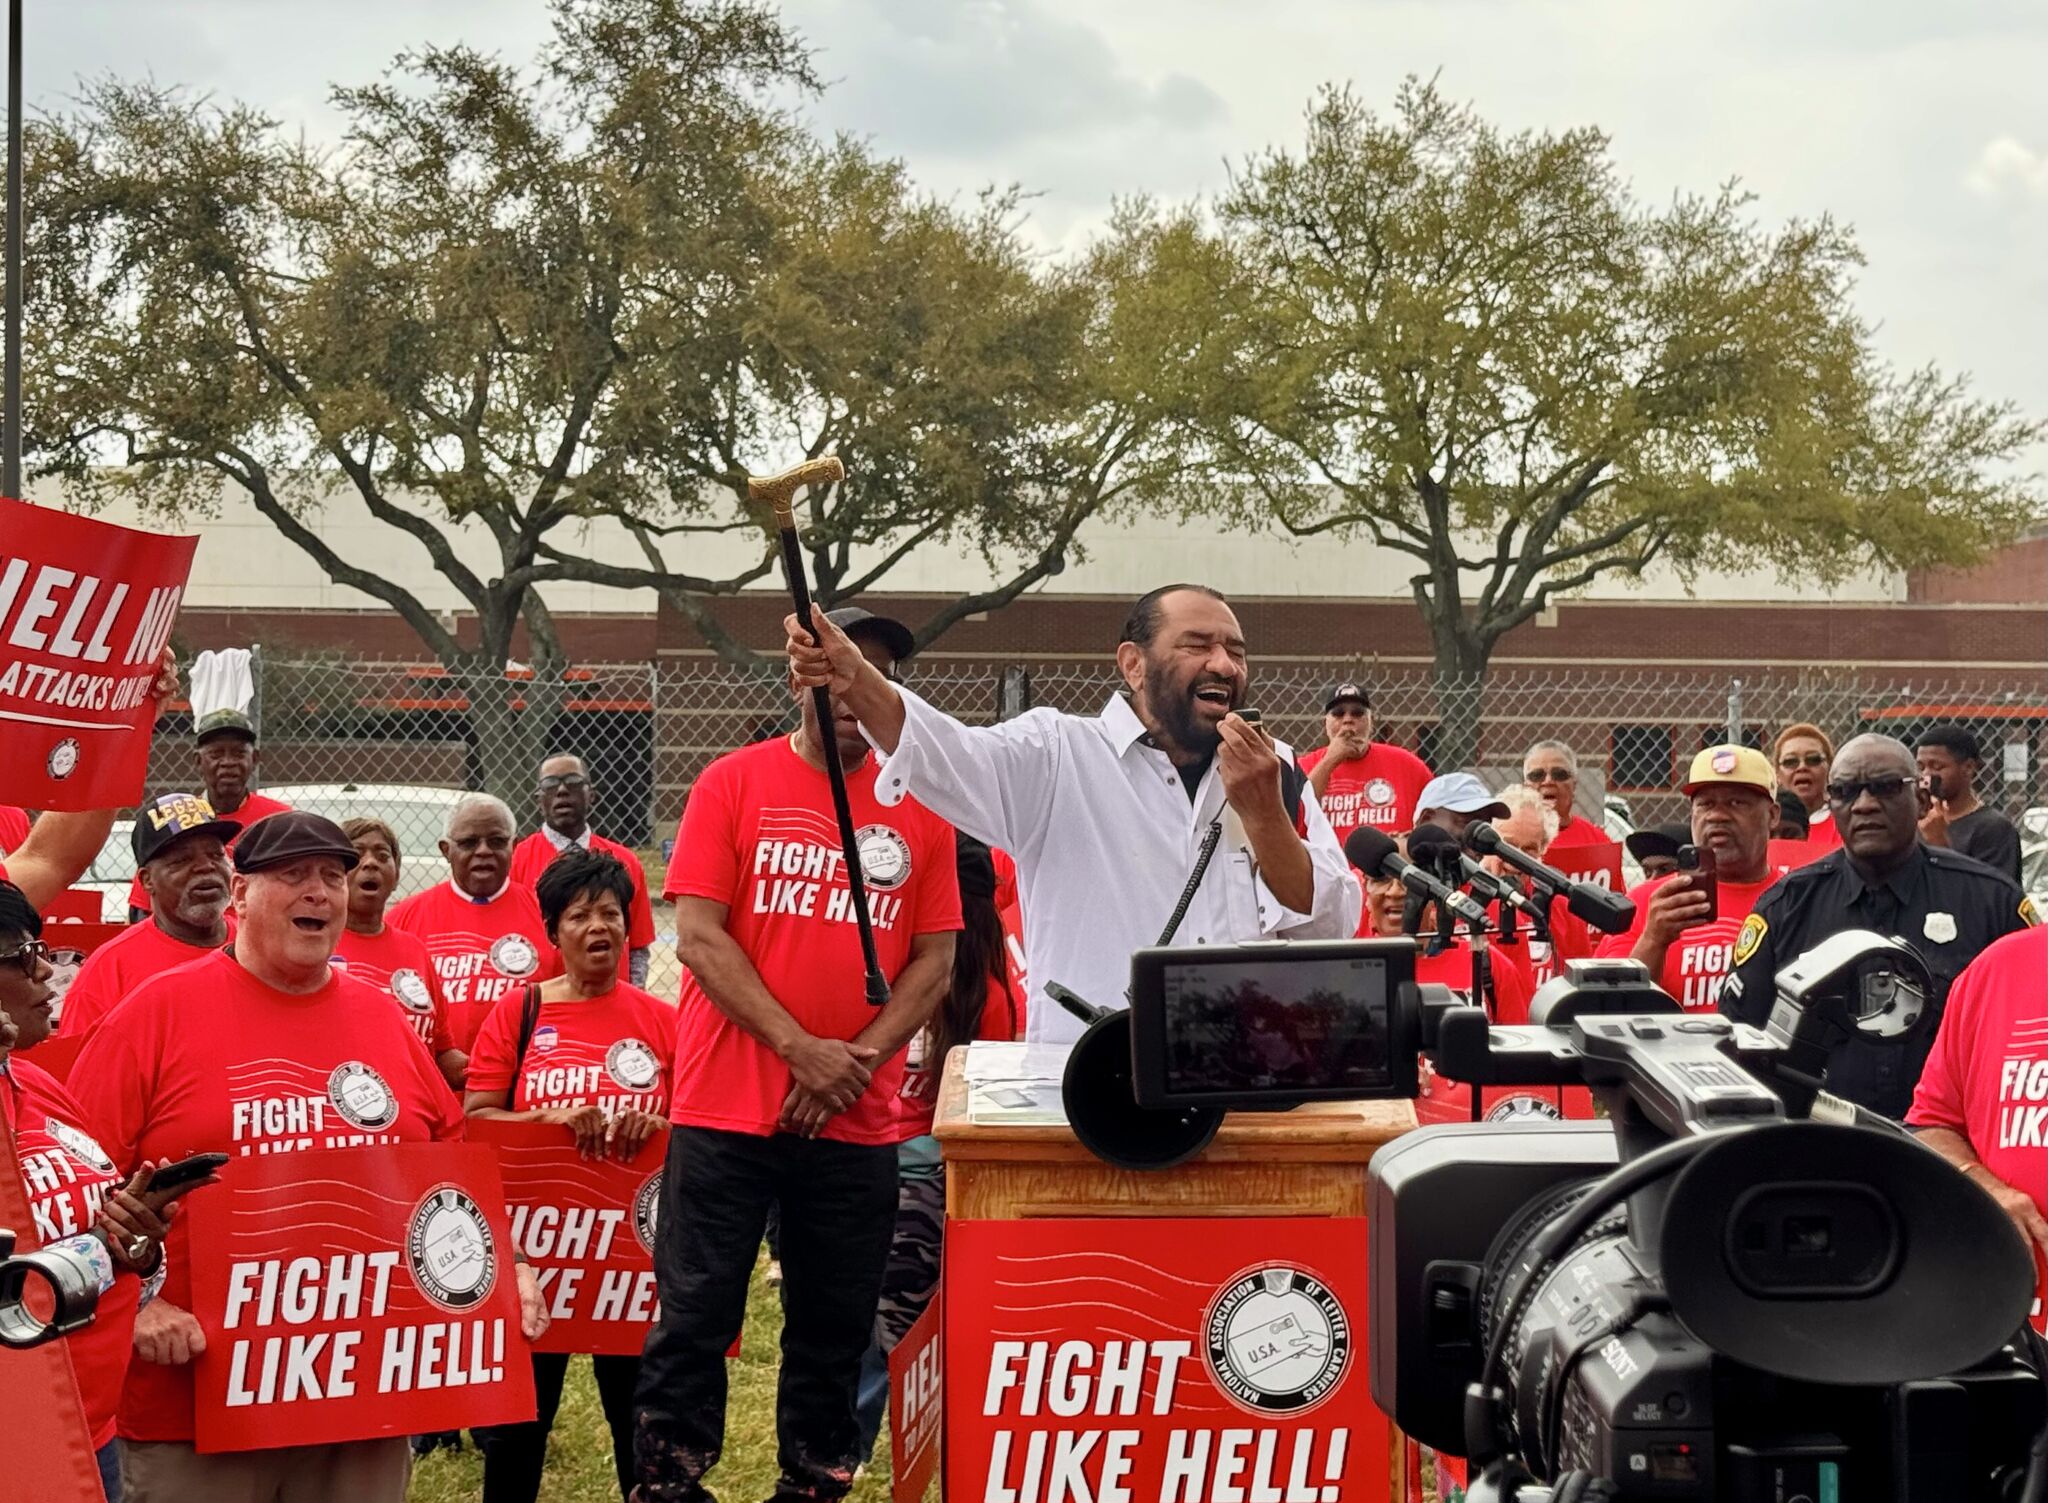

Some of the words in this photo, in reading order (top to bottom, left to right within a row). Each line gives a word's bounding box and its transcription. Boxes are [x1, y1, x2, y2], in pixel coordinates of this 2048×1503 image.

[1, 661, 114, 711] ATTACKS
[147, 798, 216, 832] LEGEN
[1324, 811, 1355, 827] IKE
[1358, 807, 1398, 825] HELL!
[754, 841, 844, 882] FIGHT
[753, 879, 821, 917] LIKE
[431, 953, 488, 979] IGHT
[442, 978, 471, 1004] KE
[1683, 975, 1726, 1007] LIK
[525, 1066, 603, 1102] FIGHT
[2000, 1059, 2048, 1102] FIG
[232, 1096, 328, 1141] FIGHT
[2000, 1105, 2048, 1150] LIK
[505, 1204, 626, 1261] IGHT
[222, 1251, 400, 1330] FIGHT
[1304, 1281, 1324, 1297] OF
[1210, 1279, 1256, 1351] ASSOCIATION
[1321, 1296, 1346, 1340] LETTER
[225, 1330, 362, 1407] LIKE
[377, 1318, 505, 1394] HELL!
[982, 1340, 1192, 1417] FIGHT
[1215, 1357, 1261, 1404] NATIONAL
[1302, 1347, 1346, 1401] CARRIERS
[1600, 1338, 1639, 1380] SONY
[901, 1333, 940, 1434] HEL
[983, 1429, 1141, 1503] LIKE
[1159, 1427, 1349, 1503] HELL!
